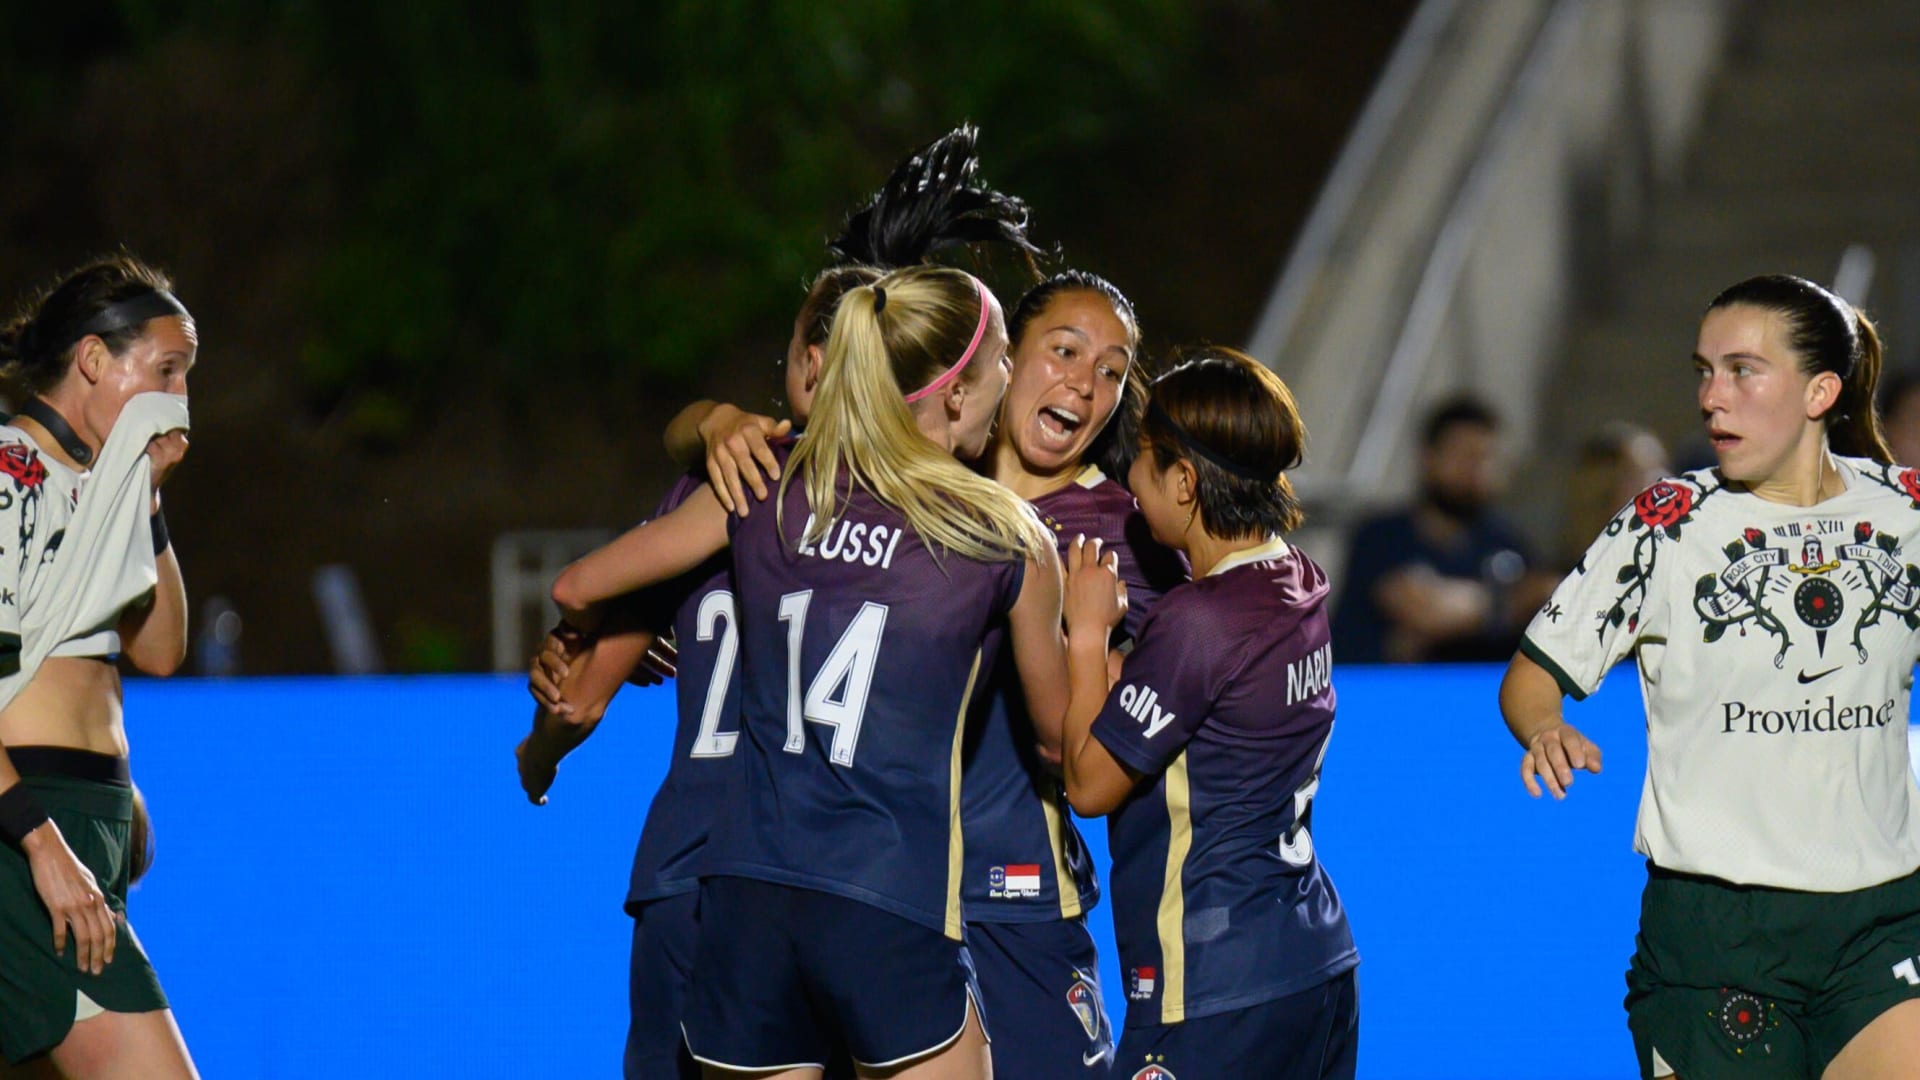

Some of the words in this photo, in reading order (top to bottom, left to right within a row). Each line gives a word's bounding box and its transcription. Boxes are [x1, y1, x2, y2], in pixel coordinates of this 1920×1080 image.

[798, 512, 902, 570] LUSSI
[1726, 561, 1750, 582] ROSE
[1753, 552, 1777, 566] CITY
[1849, 547, 1872, 559] TILL
[1883, 559, 1897, 575] DIE
[690, 590, 740, 758] 2
[778, 589, 889, 767] 14
[1119, 684, 1176, 739] ally
[1721, 695, 1895, 734] Providence
